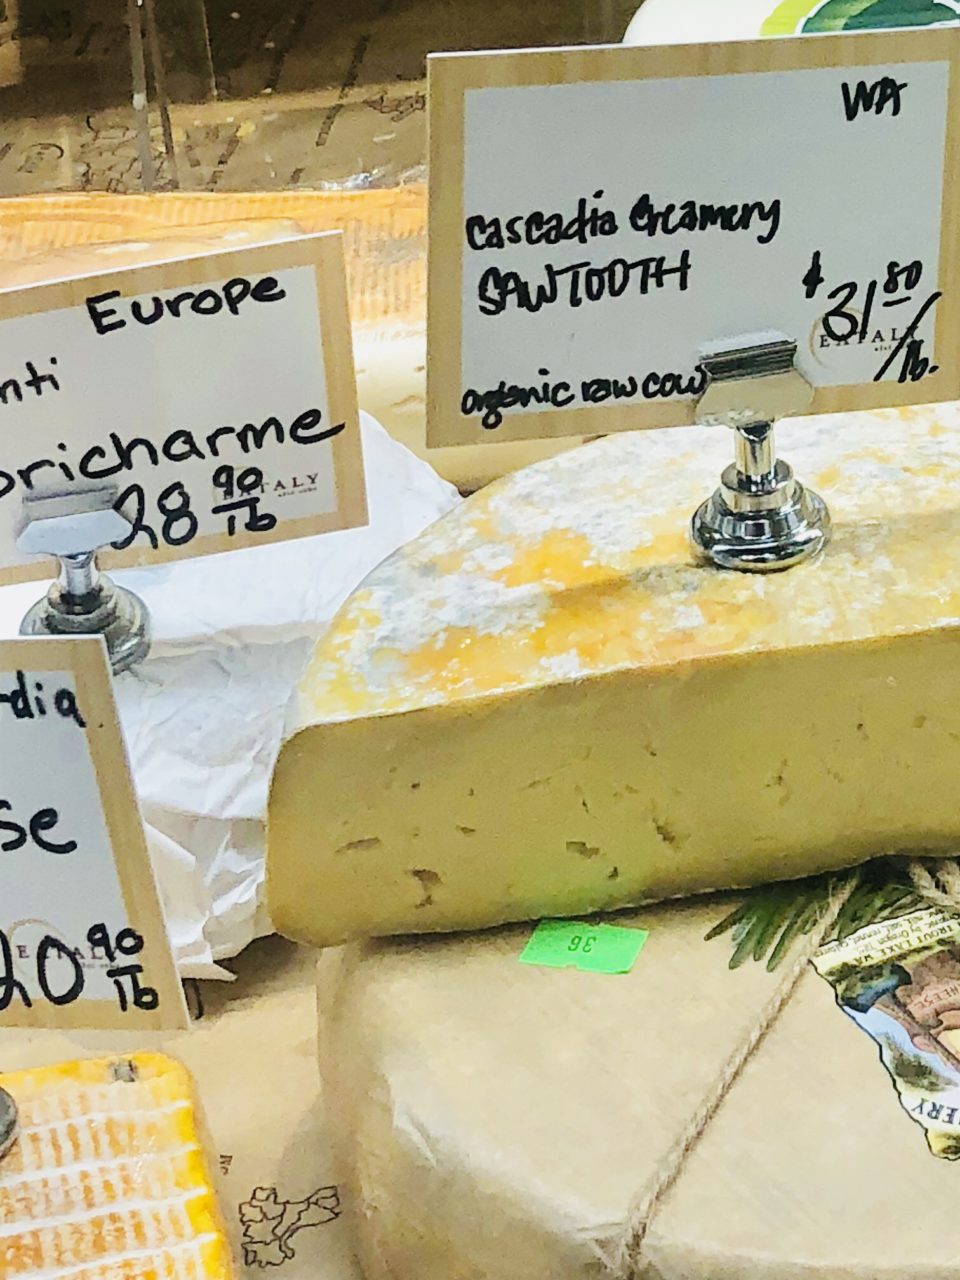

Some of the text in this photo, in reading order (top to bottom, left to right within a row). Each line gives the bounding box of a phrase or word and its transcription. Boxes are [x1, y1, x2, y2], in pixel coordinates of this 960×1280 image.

[841, 77, 908, 121] WA
[86, 276, 286, 334] Europe
[478, 250, 691, 315] SAWTOOTH
